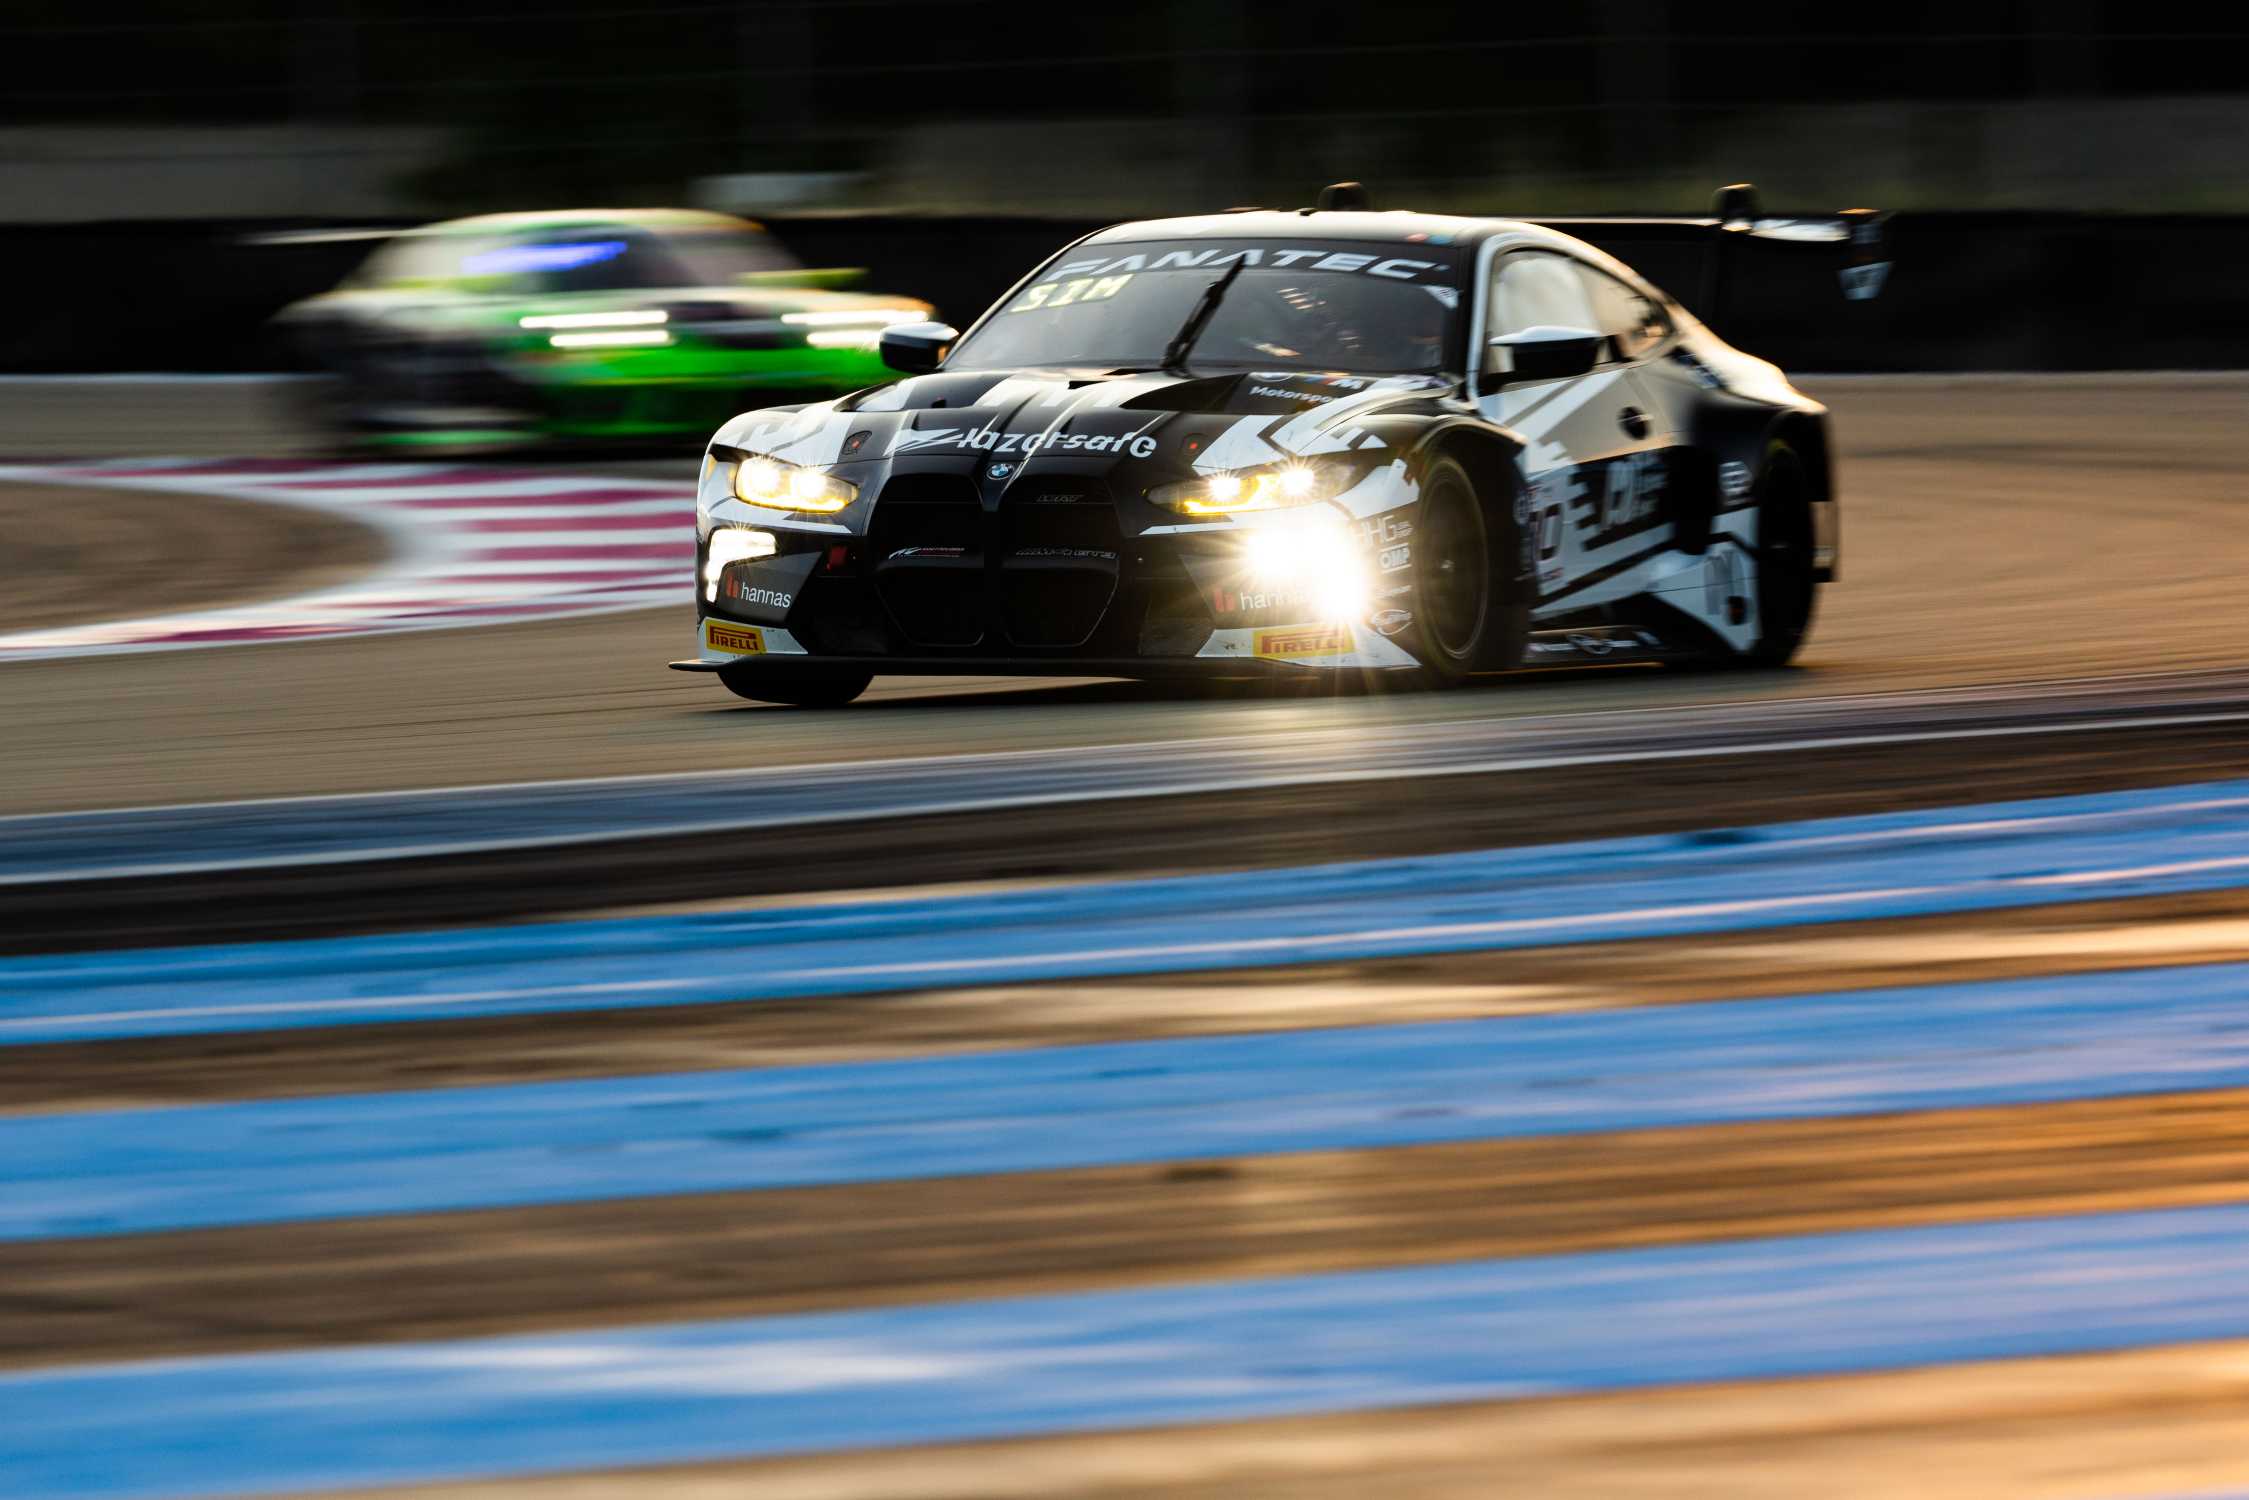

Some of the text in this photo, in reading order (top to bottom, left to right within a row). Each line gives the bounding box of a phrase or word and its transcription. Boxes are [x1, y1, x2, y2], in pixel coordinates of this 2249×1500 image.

[1044, 248, 1438, 282] FANATEC
[957, 427, 1158, 458] lazersafe
[740, 582, 793, 609] hannas
[709, 625, 760, 651] PIRELLI
